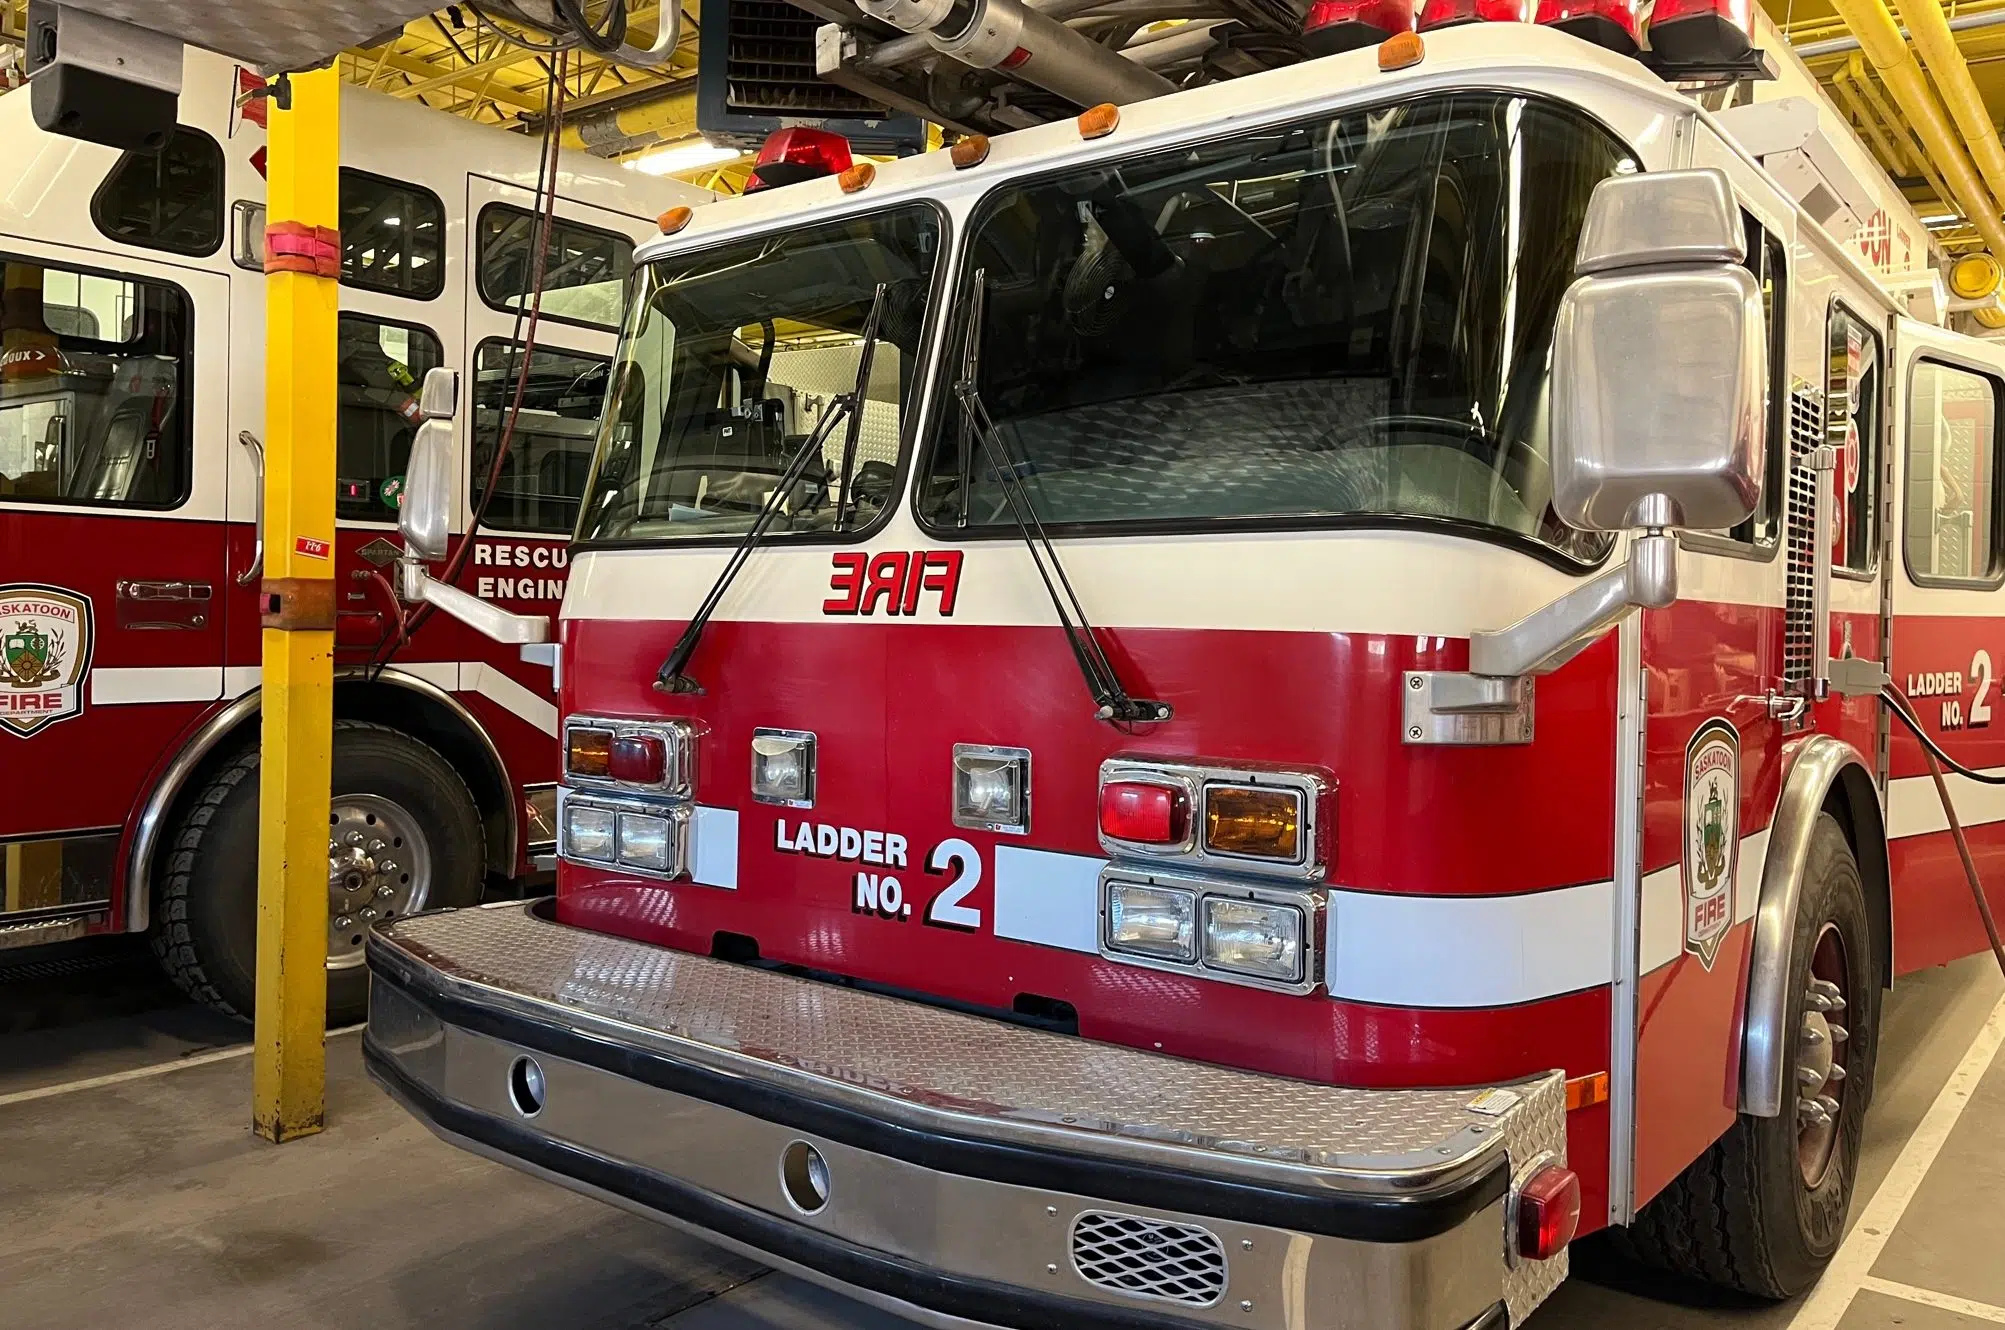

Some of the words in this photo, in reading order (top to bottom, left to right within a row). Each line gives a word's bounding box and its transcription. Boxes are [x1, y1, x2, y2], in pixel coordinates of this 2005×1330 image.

[475, 544, 568, 568] RESCU
[478, 577, 563, 599] ENGIN
[0, 603, 71, 619] SKATOON
[1908, 672, 1962, 696] LADDER
[1942, 701, 1963, 726] NO.
[1970, 649, 1992, 723] 2
[1695, 751, 1732, 780] SASKATOON
[776, 819, 907, 867] LADDER
[857, 872, 911, 915] NO.
[930, 838, 982, 928] 2
[1694, 892, 1726, 932] FIRE
